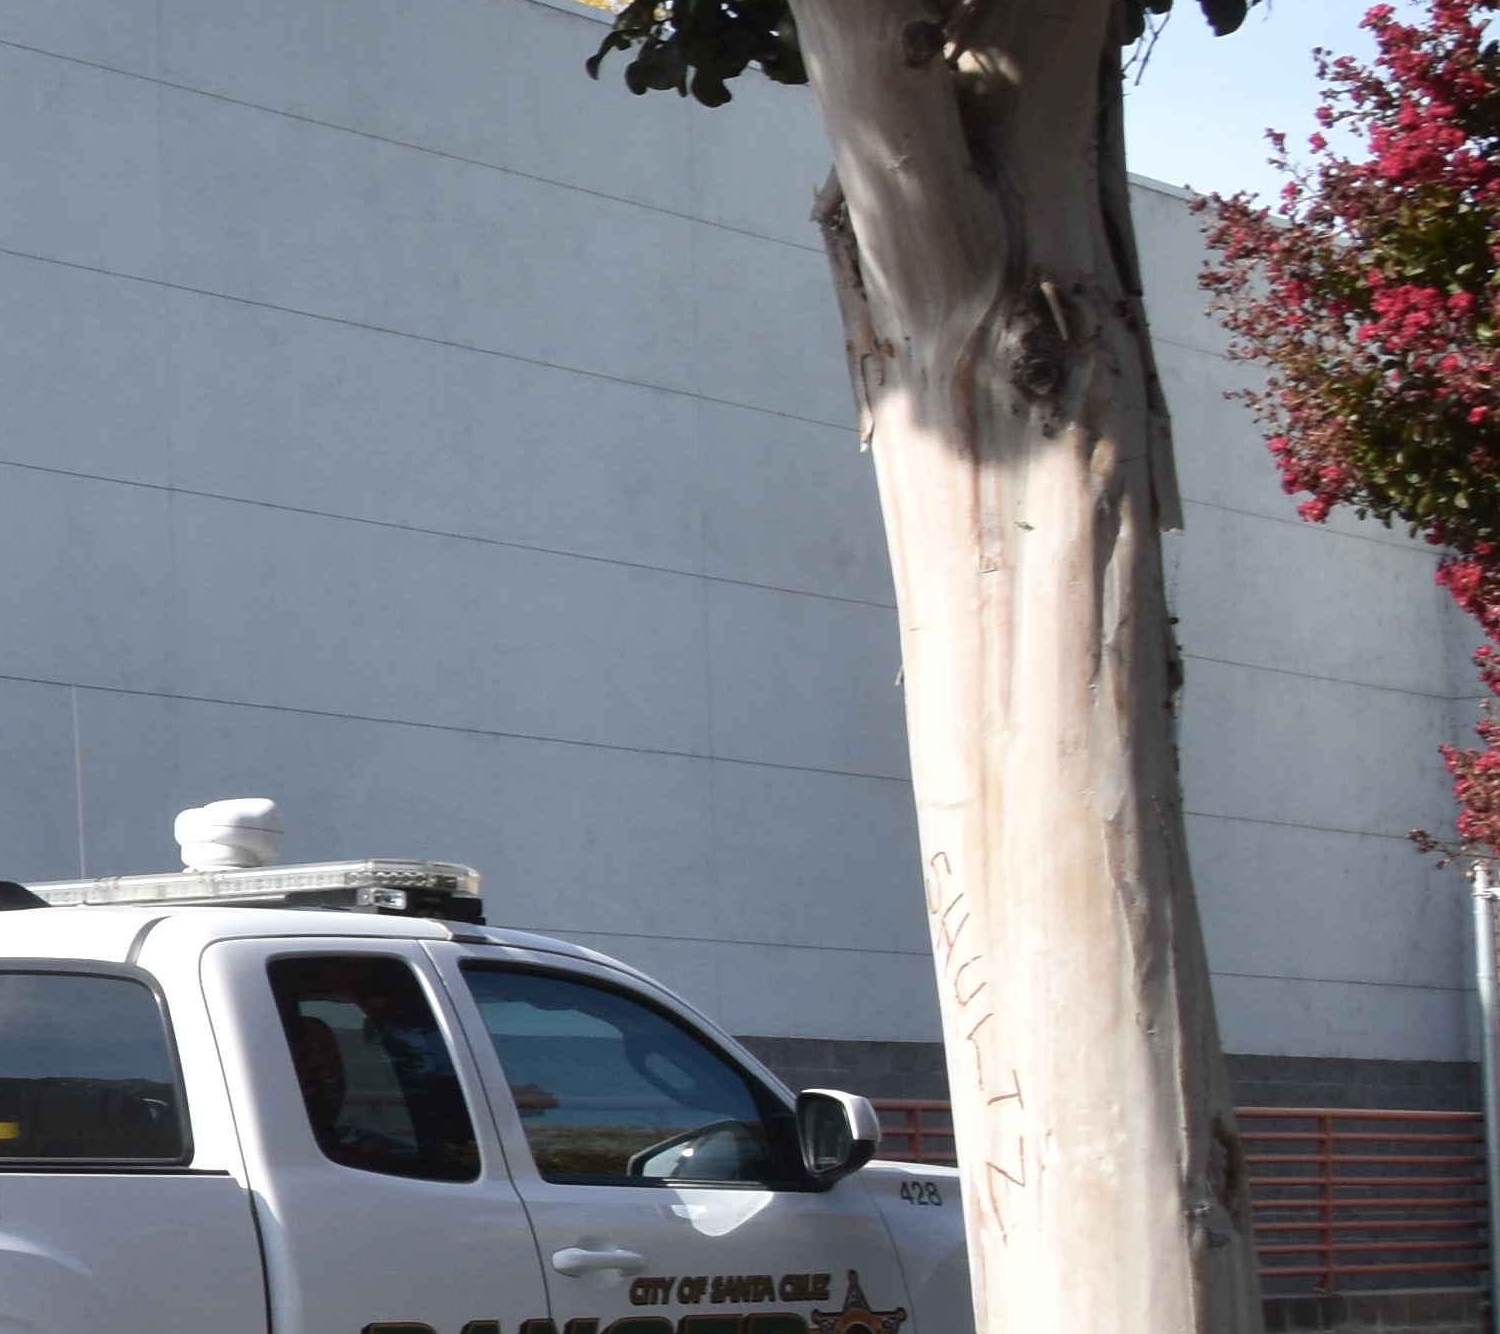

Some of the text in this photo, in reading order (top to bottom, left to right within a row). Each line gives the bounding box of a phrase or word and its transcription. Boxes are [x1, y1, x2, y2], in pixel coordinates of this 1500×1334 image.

[900, 1181, 943, 1207] 428
[629, 1273, 832, 1306] CITY OF SANTA CRUZ
